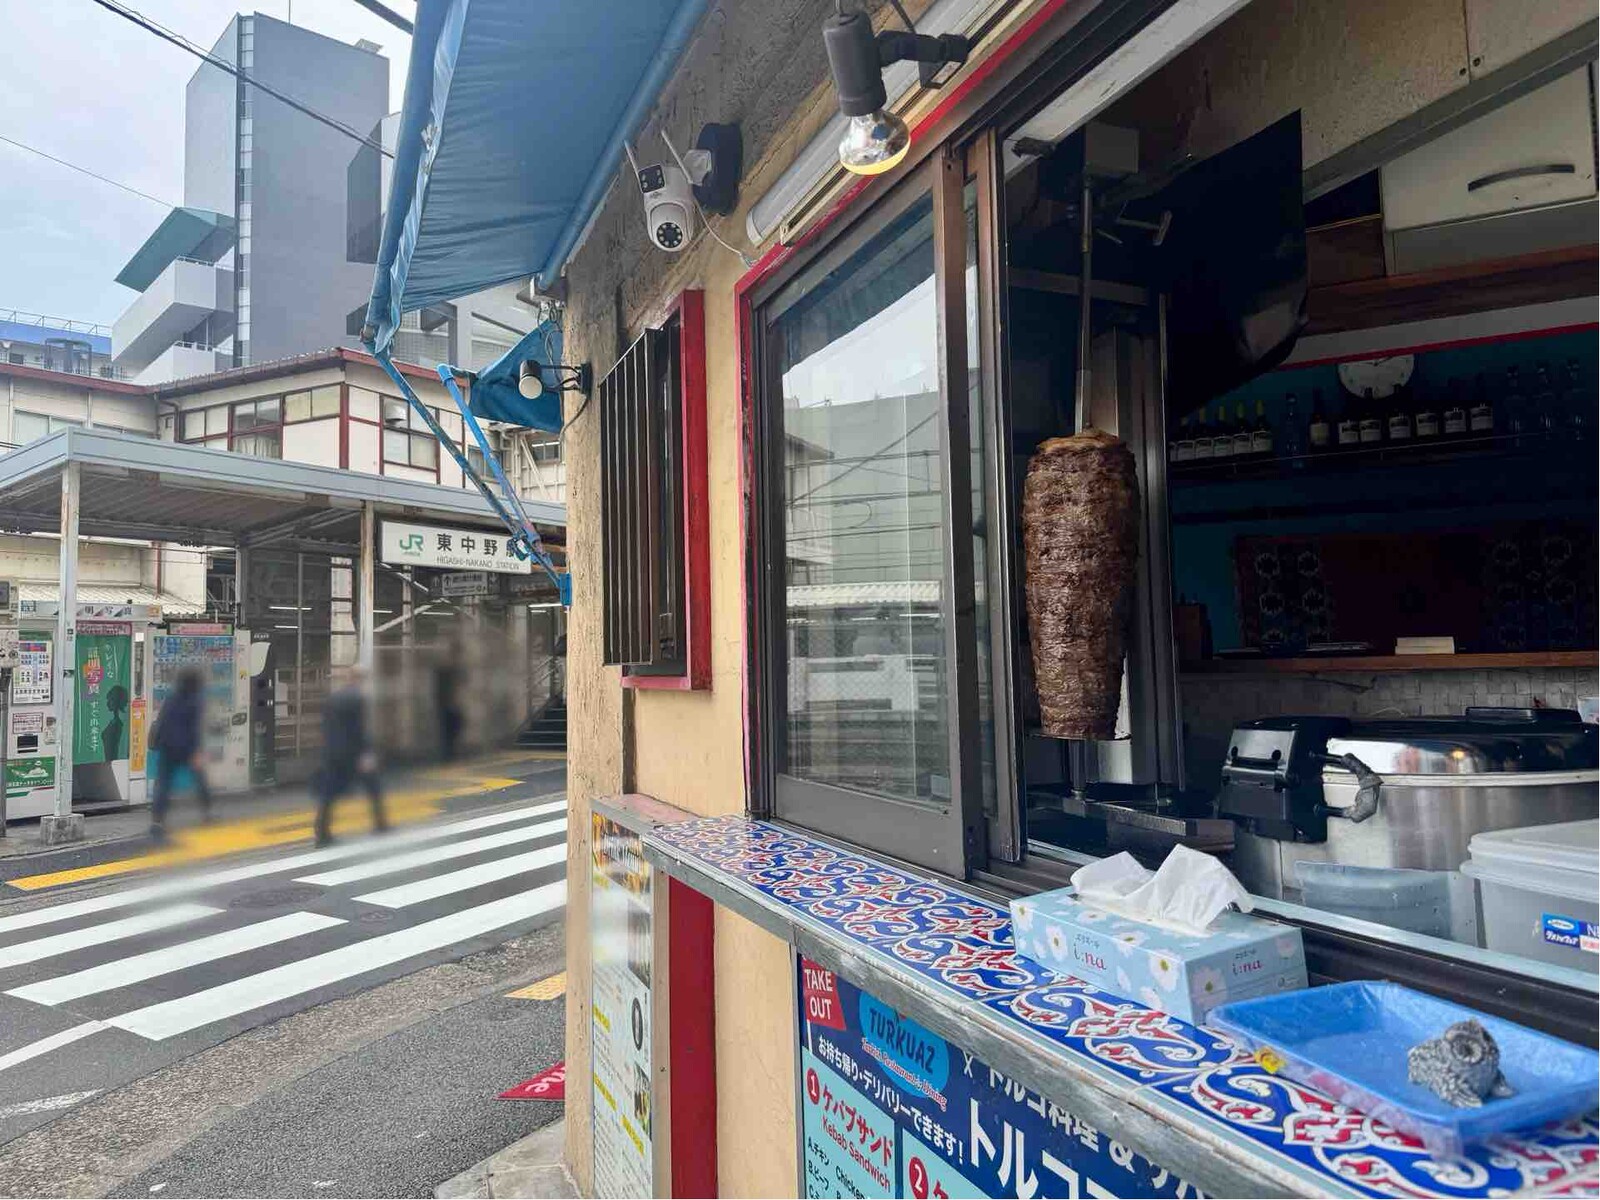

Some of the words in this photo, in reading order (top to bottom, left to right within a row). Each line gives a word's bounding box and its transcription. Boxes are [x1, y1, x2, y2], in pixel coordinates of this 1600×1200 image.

[399, 533, 424, 552] JR
[436, 532, 515, 559] 東中野
[804, 968, 833, 992] TAKE
[809, 996, 832, 1020] OUT
[868, 1007, 936, 1074] TURKUAZ
[822, 1083, 894, 1167] ケバブサンド
[969, 1096, 1122, 1199] トルコ
[821, 1115, 849, 1151] Kebab
[848, 1142, 891, 1193] Sandwich
